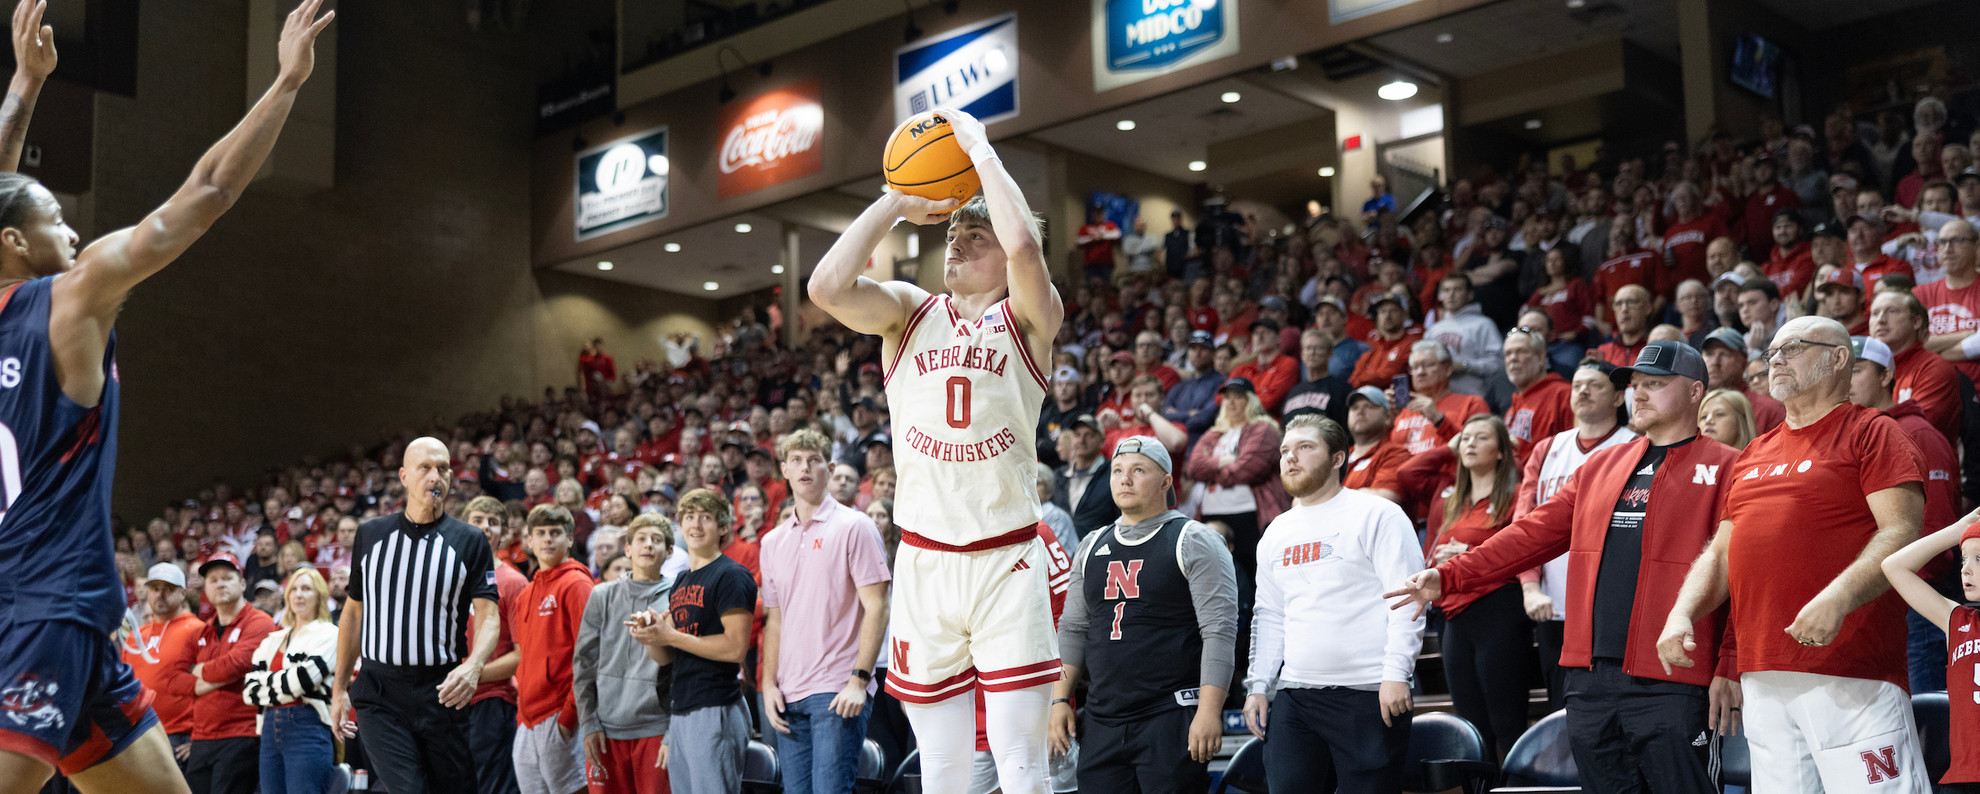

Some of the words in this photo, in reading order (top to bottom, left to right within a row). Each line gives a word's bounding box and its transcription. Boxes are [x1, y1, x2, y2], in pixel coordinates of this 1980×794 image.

[1126, 5, 1203, 48] MIDCO
[931, 50, 1000, 105] LEW
[914, 345, 1008, 377] NEBRASKA
[945, 375, 972, 430] 0
[905, 425, 1016, 462] CORNHUSKERS
[1692, 463, 1720, 486] N
[812, 537, 824, 550] N
[1282, 541, 1322, 567] CORN
[1104, 559, 1144, 600] N
[1110, 601, 1126, 640] 1
[892, 636, 910, 676] N
[1860, 745, 1900, 784] N
